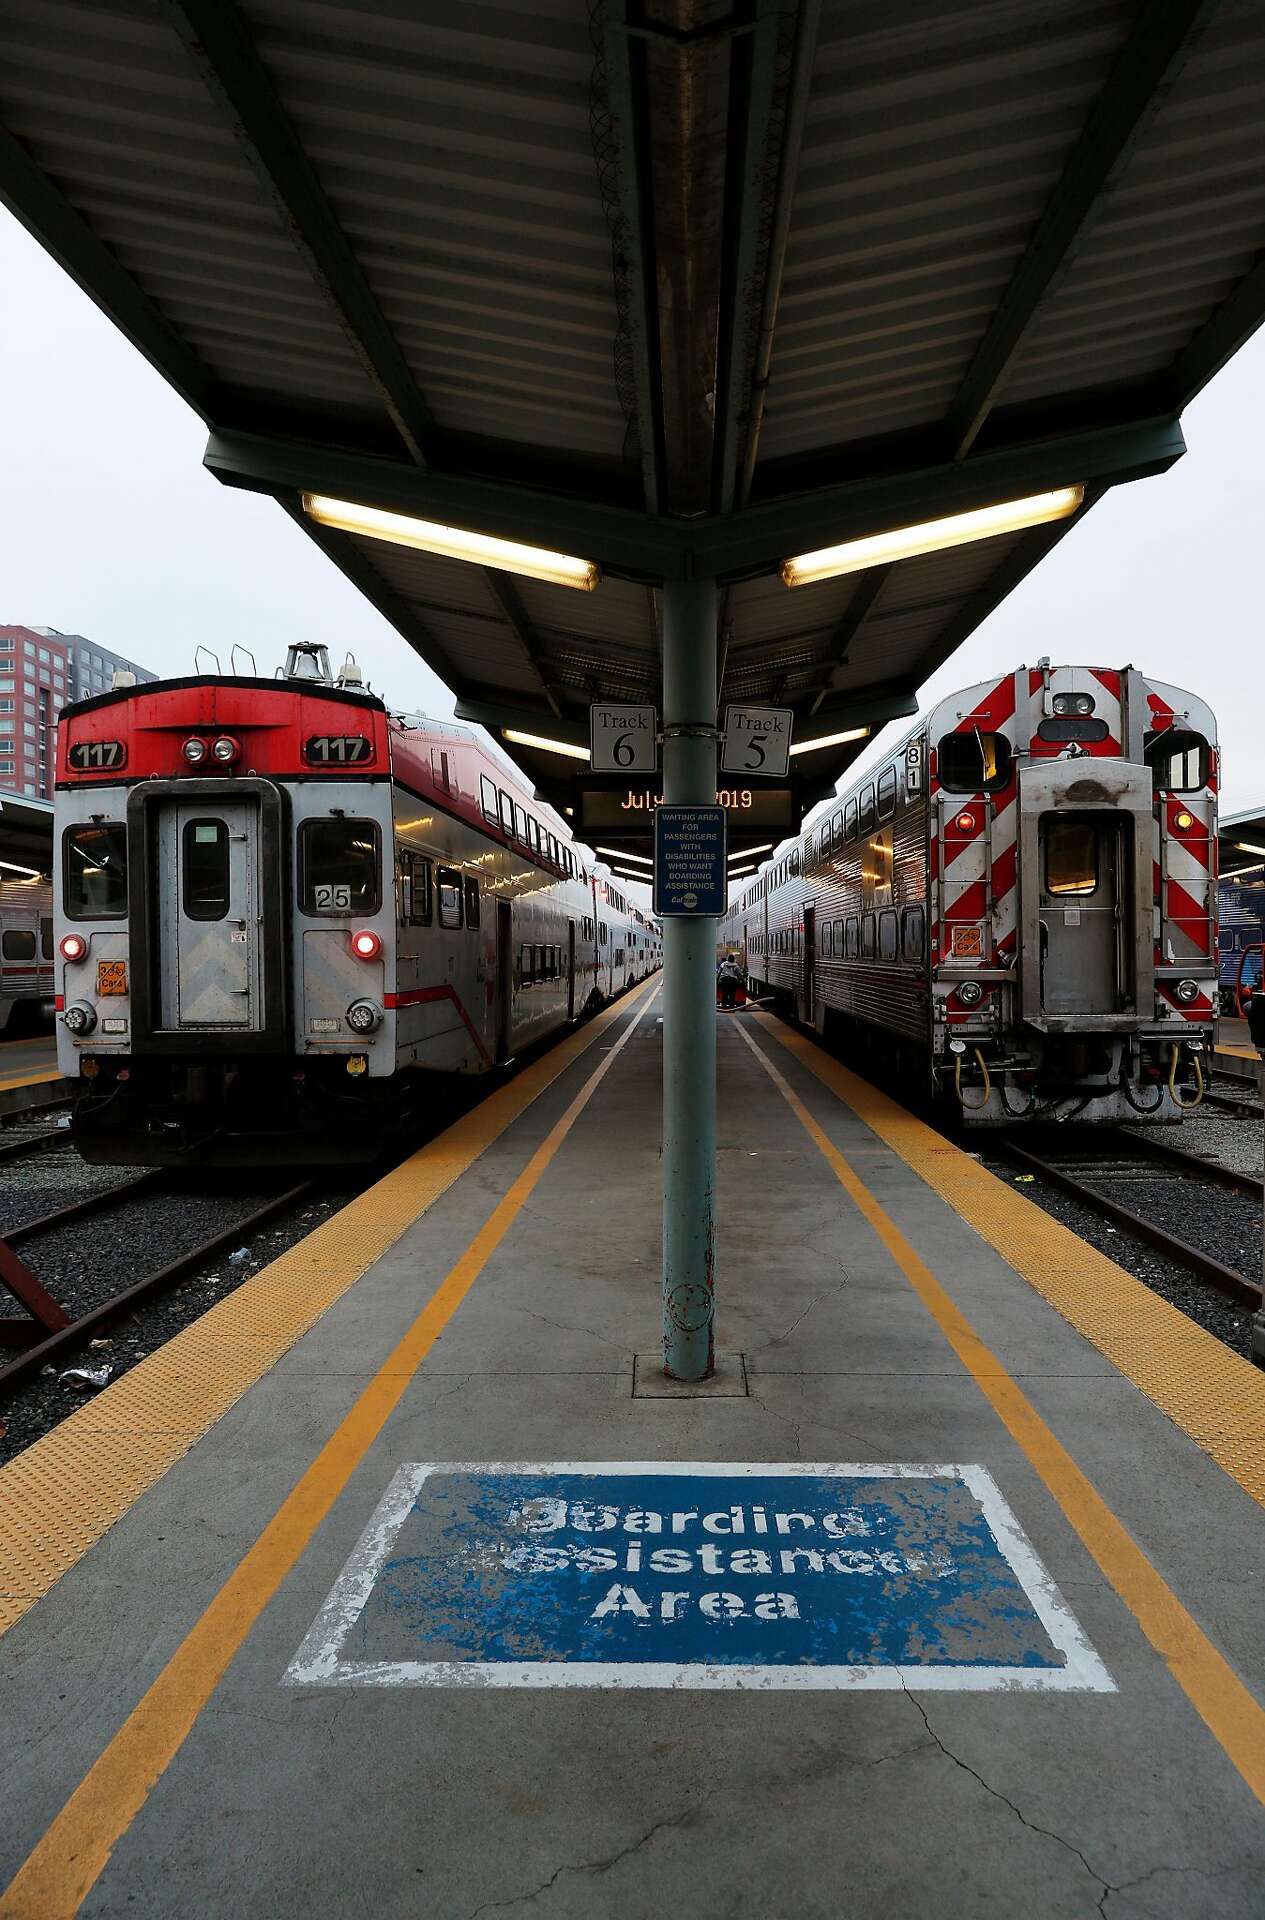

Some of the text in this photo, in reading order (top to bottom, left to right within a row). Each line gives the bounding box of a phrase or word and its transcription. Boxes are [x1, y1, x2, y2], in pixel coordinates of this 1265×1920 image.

[599, 712, 648, 729] Track
[734, 713, 784, 733] Track
[76, 743, 118, 767] 117
[313, 737, 364, 762] 117
[613, 733, 635, 767] 6
[743, 736, 768, 770] 5
[714, 790, 753, 808] 019
[664, 833, 717, 841] PASSENGERS
[682, 823, 699, 831] FOR
[665, 882, 715, 890] ASSISTANCE
[669, 872, 712, 880] BOARDING
[316, 888, 350, 908] 25
[588, 1583, 802, 1621] Area
